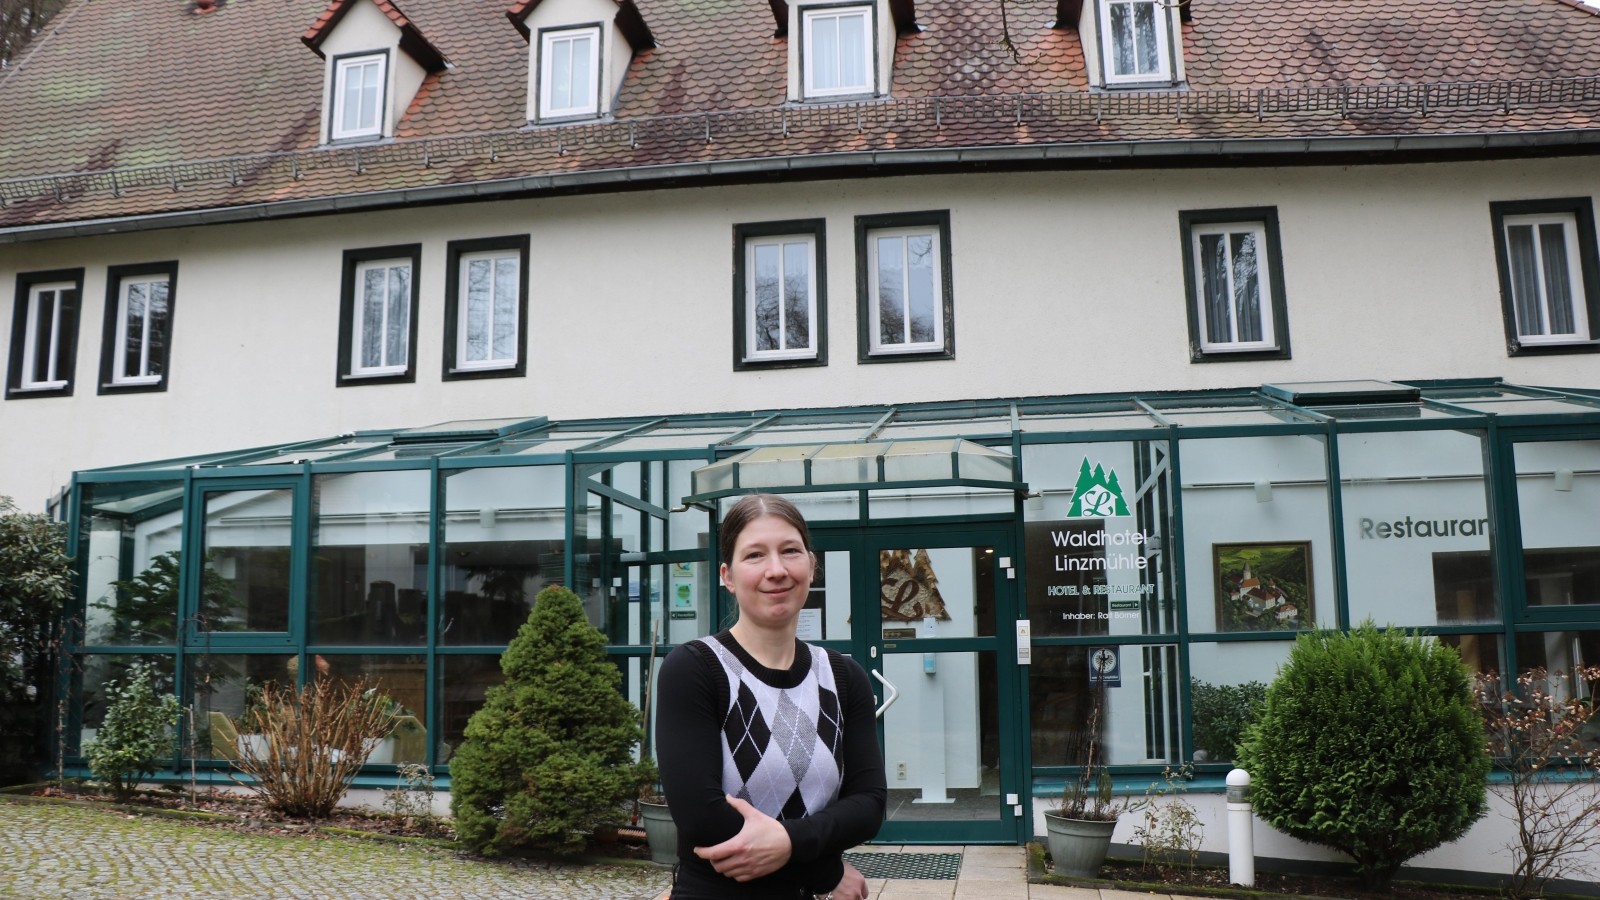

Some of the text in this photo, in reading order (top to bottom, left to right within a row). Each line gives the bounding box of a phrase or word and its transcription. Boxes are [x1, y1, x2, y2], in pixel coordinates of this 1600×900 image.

[1359, 515, 1489, 540] Restauran
[1051, 528, 1147, 548] Waldhotel
[1055, 553, 1148, 573] Linzmühle
[1047, 583, 1155, 596] HOTEL & RESTAURANT
[1062, 612, 1096, 620] Inhaber:
